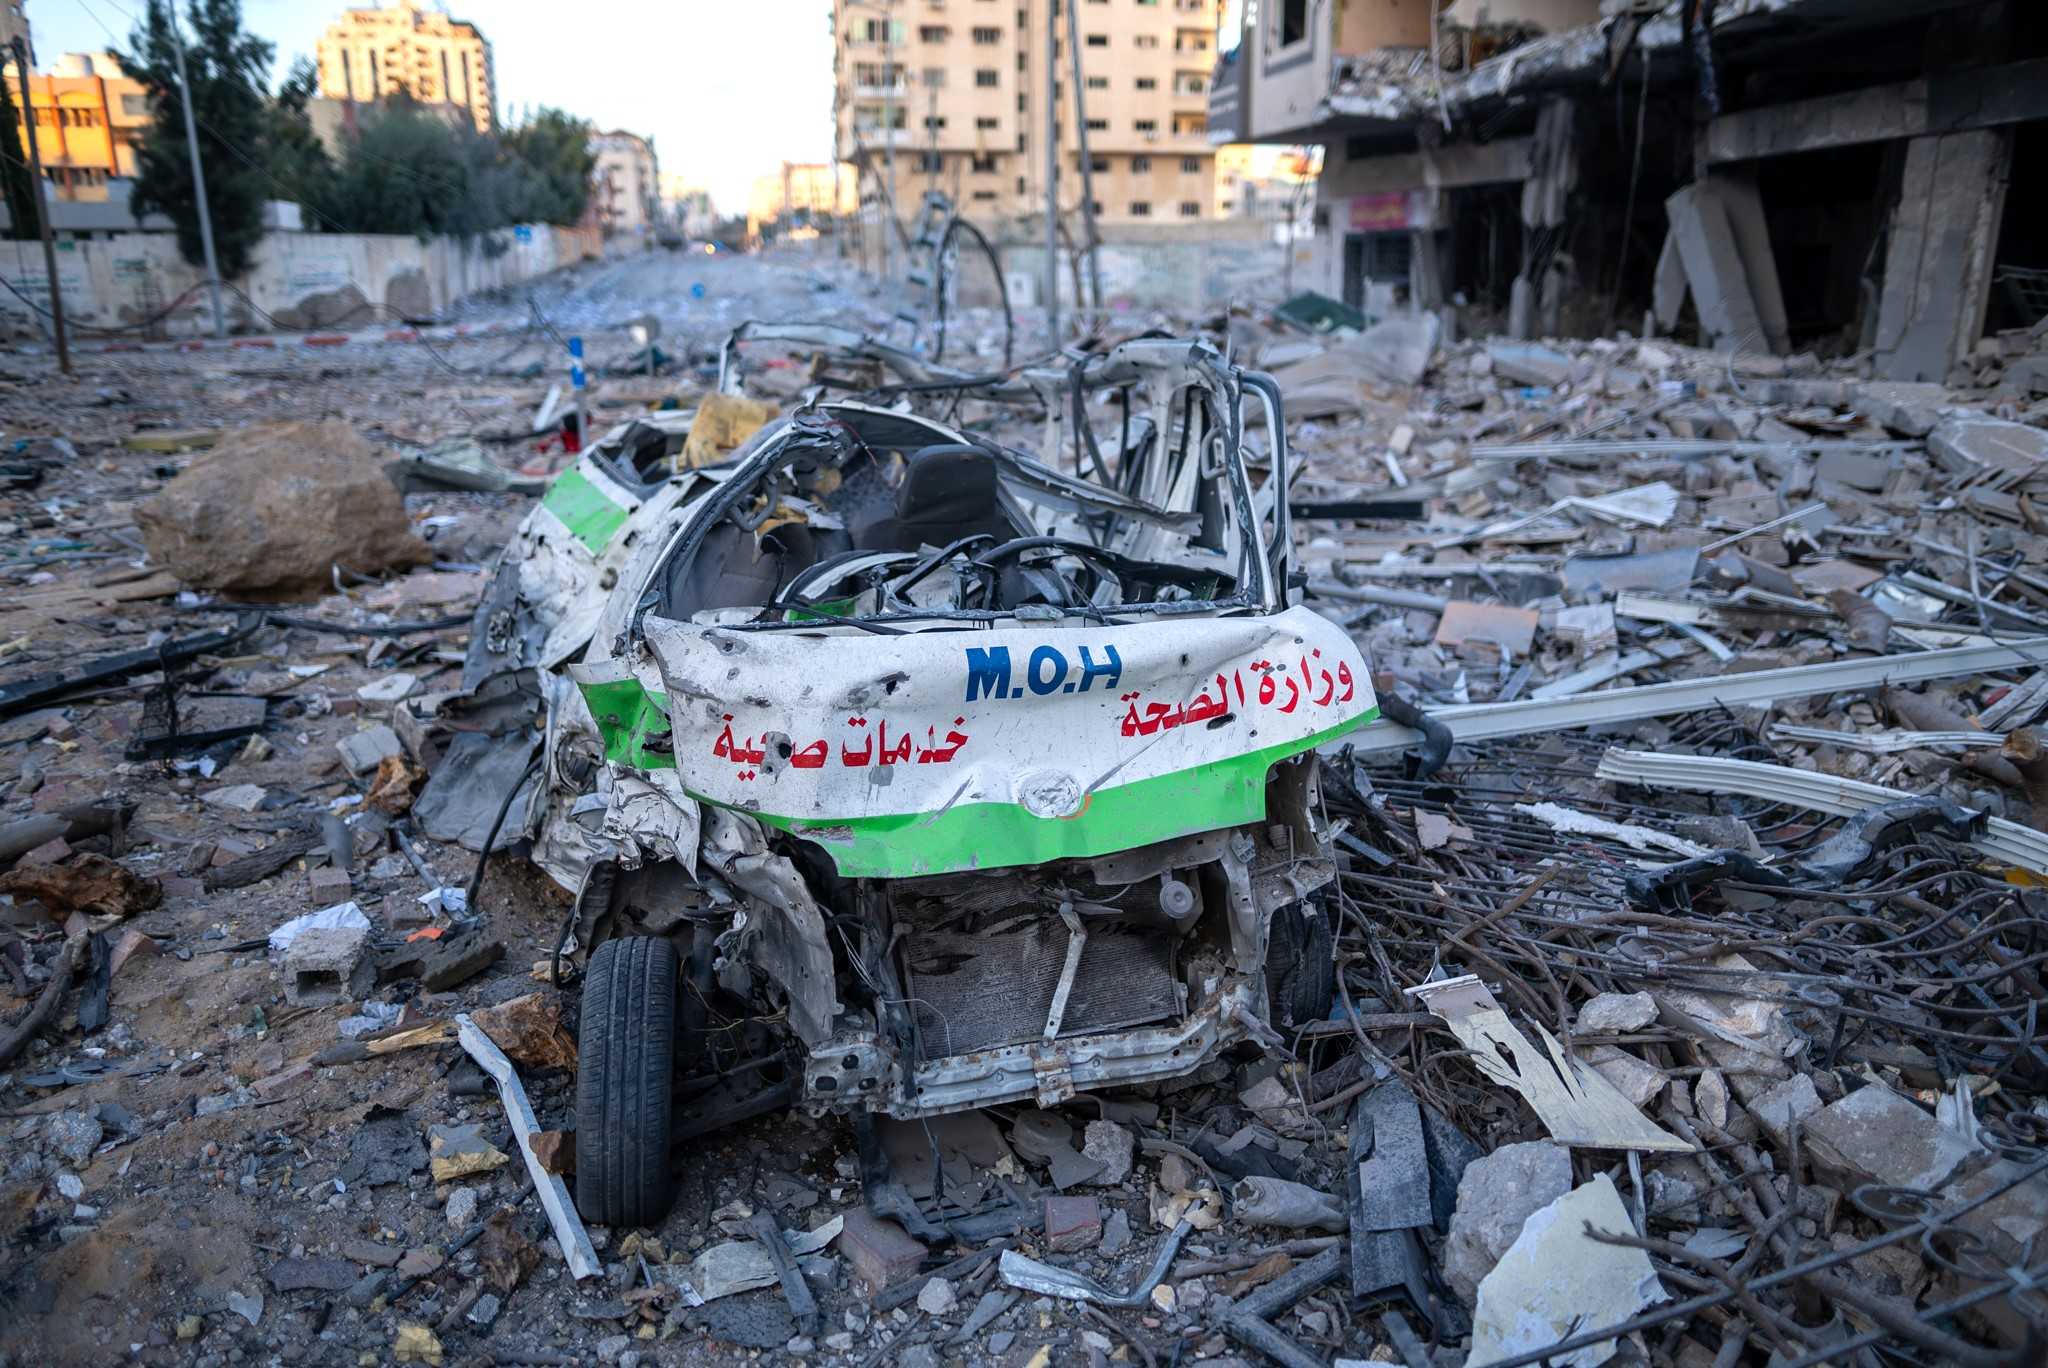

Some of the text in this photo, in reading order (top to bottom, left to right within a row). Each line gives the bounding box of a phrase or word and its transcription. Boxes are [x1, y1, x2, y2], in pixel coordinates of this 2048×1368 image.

[965, 644, 1123, 702] M.O.H
[1120, 647, 1354, 737] وزارة الصحة
[841, 714, 969, 768] خدمات
